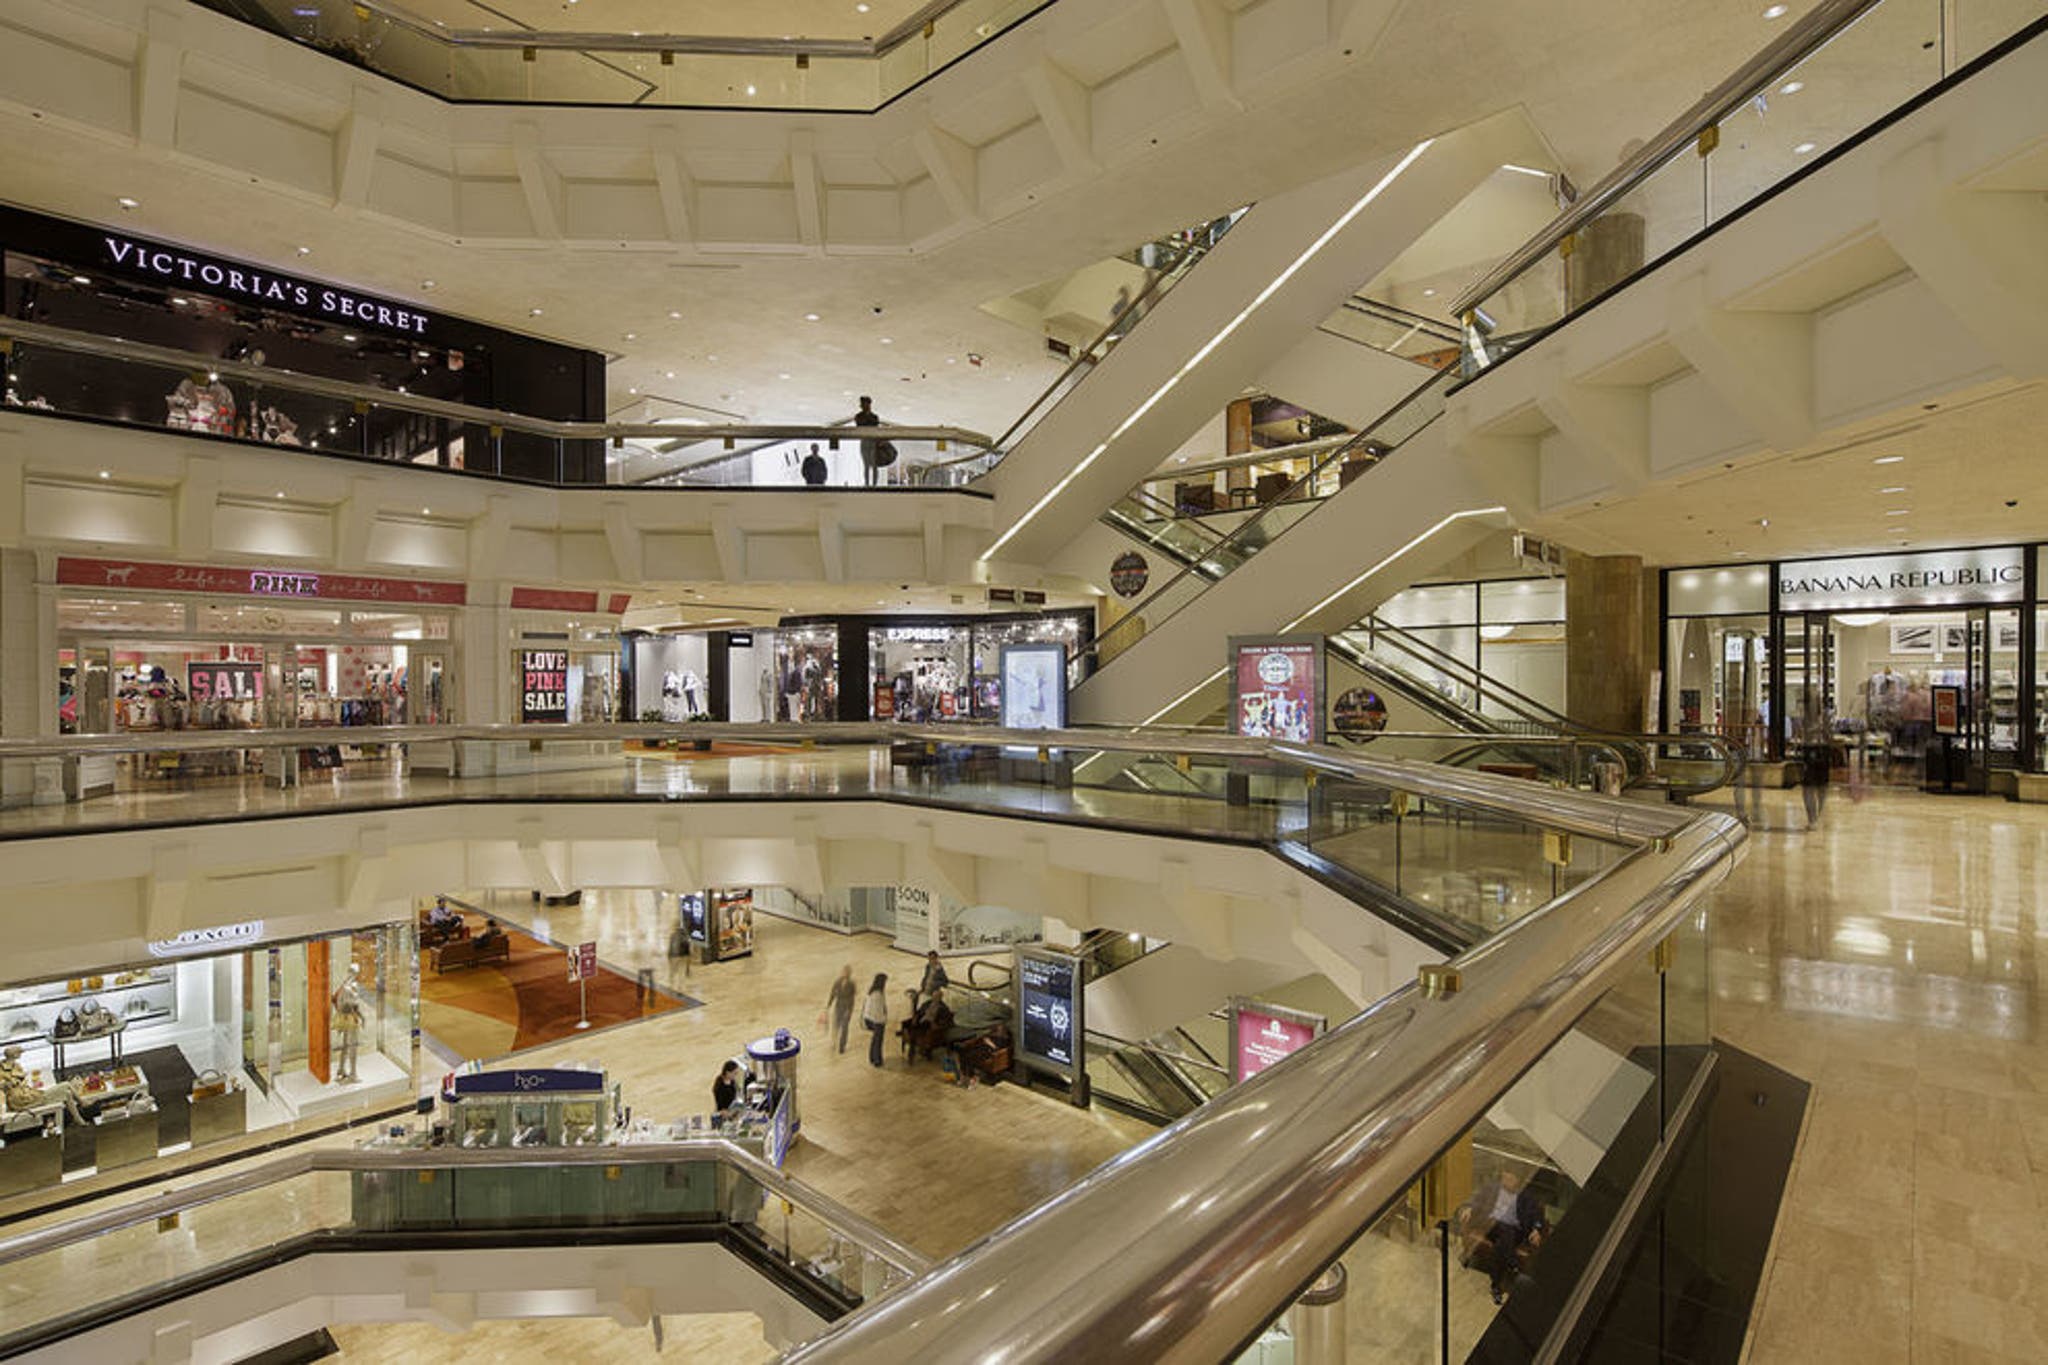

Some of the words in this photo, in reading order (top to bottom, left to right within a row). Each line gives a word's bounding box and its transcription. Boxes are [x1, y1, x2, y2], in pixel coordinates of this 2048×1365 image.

[105, 237, 309, 305] VICTORIA'S
[322, 291, 428, 333] SECRET
[253, 573, 318, 594] PINK
[1780, 573, 1882, 594] BANANA
[1889, 565, 2023, 589] REPUBLIC
[887, 627, 951, 640] EXPRESS
[525, 651, 566, 671] LOVE
[525, 671, 566, 690] PINK
[525, 692, 566, 711] SALE
